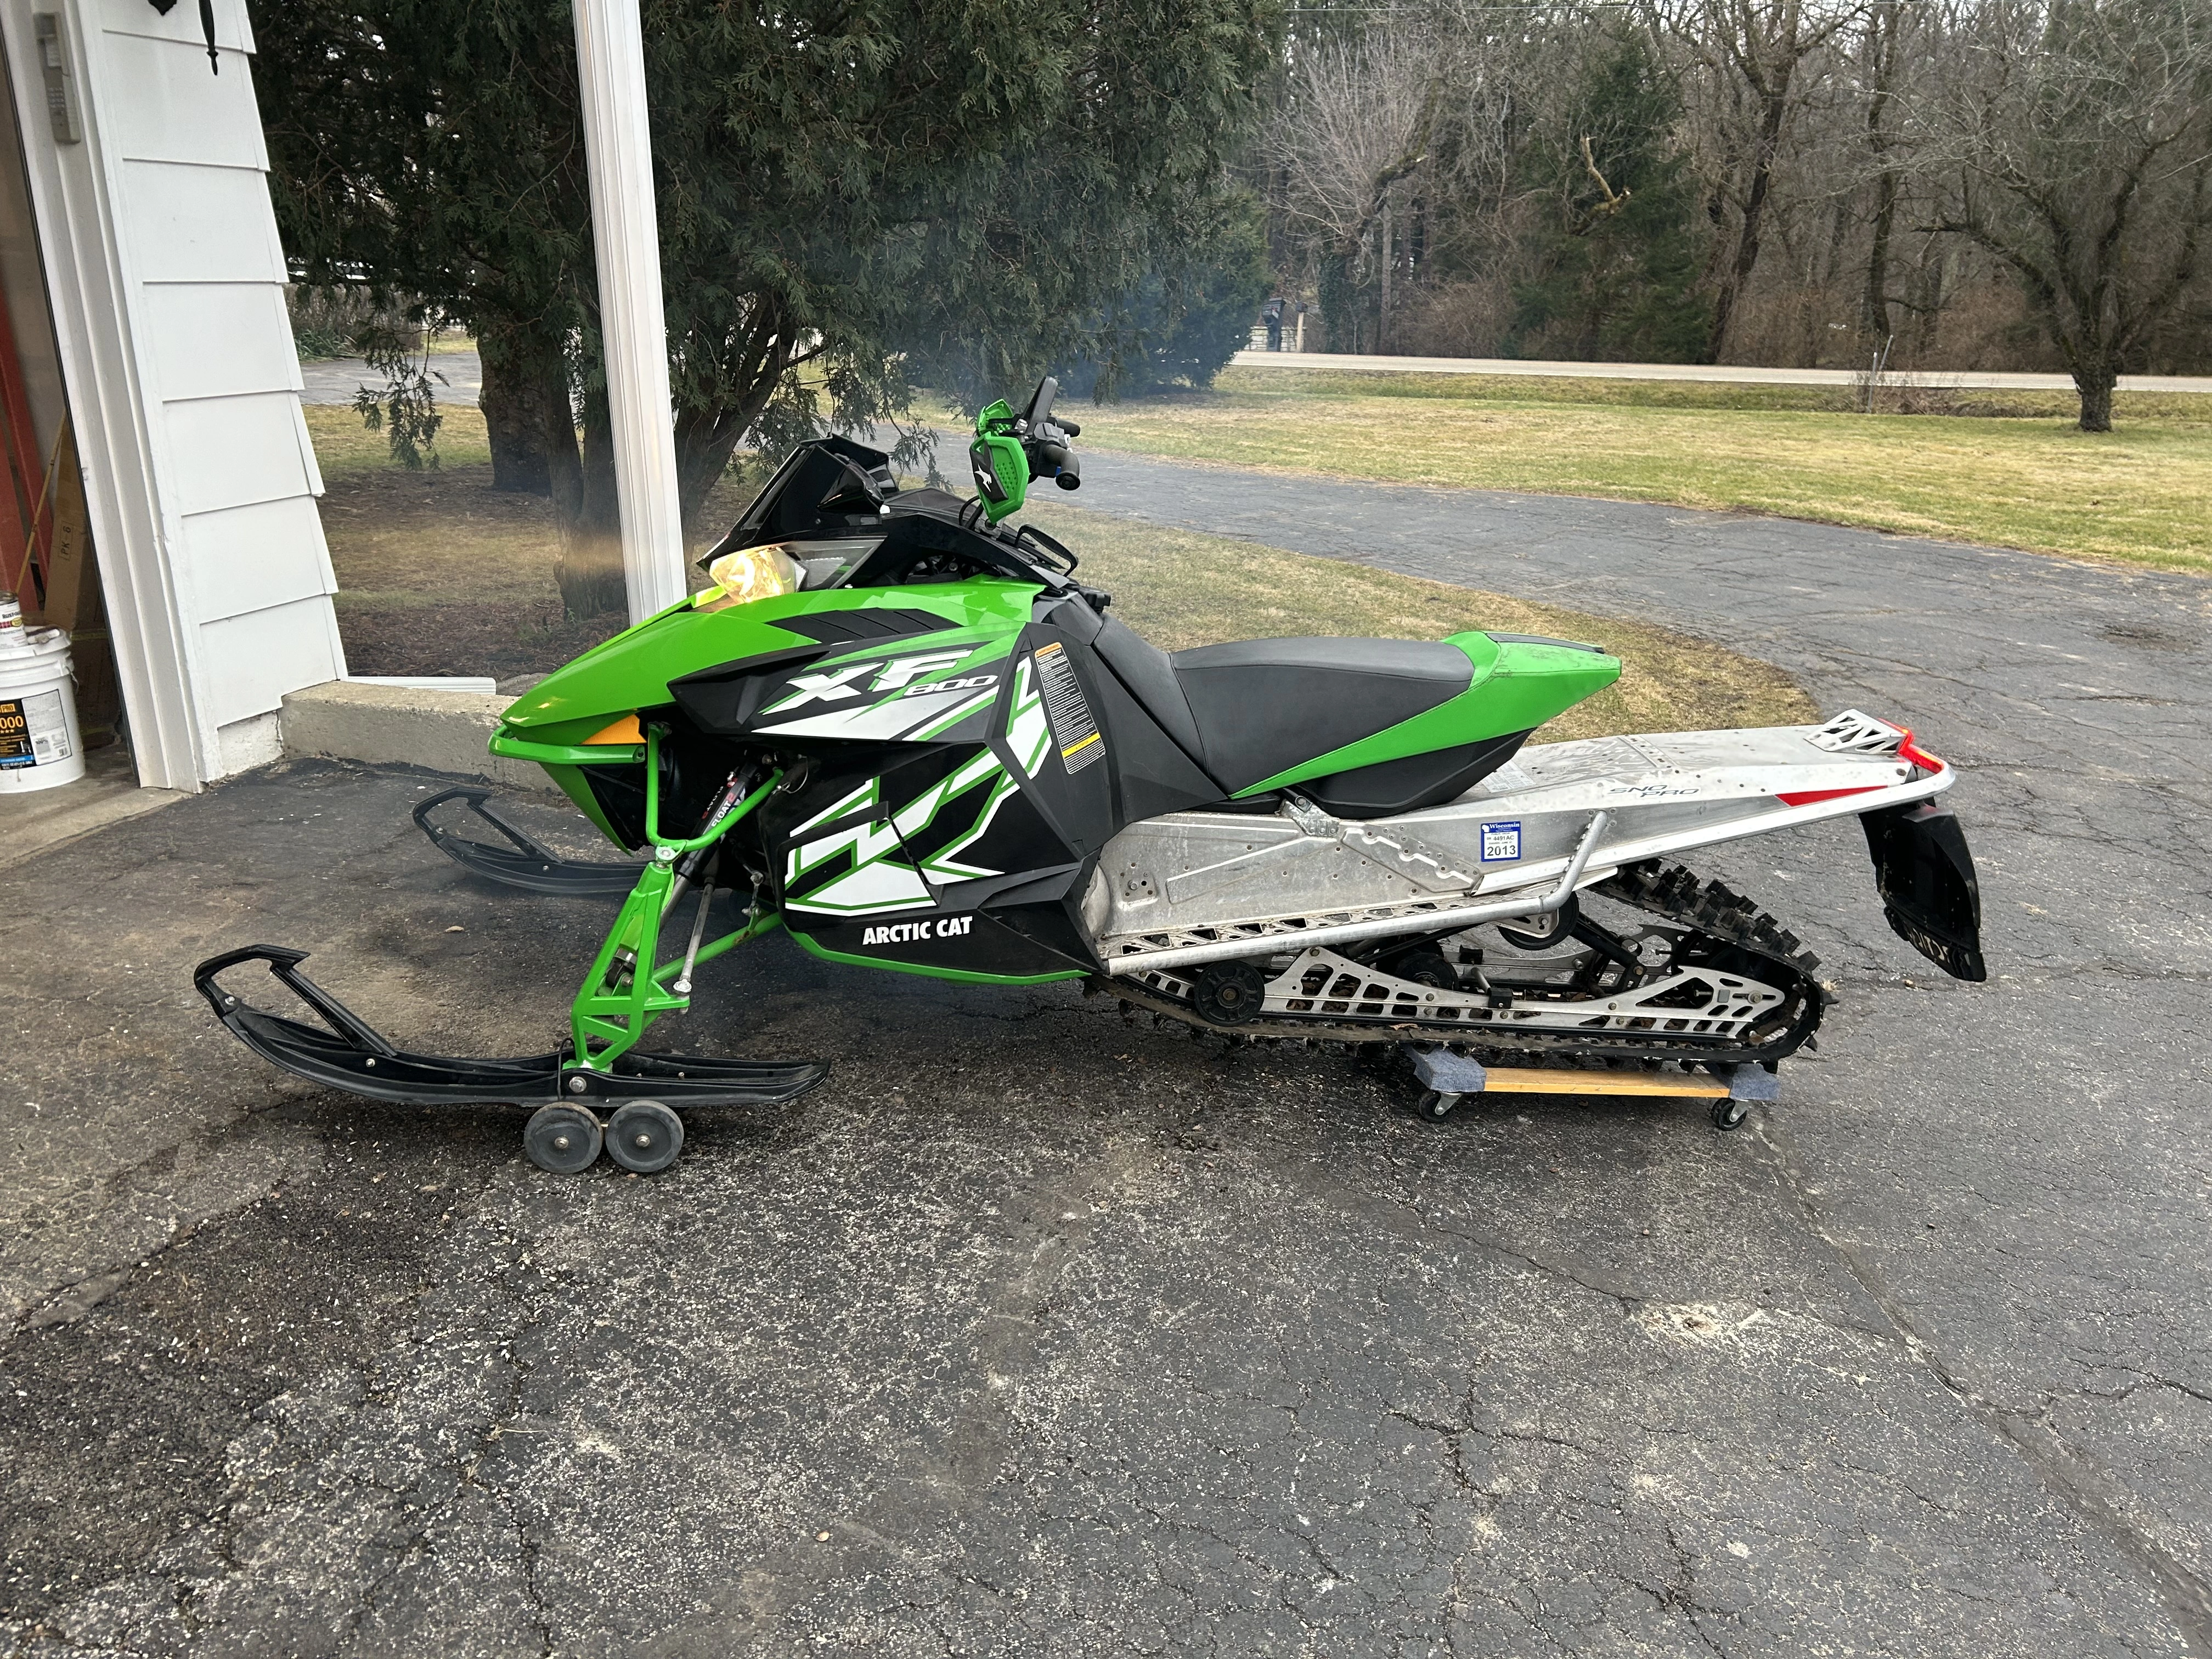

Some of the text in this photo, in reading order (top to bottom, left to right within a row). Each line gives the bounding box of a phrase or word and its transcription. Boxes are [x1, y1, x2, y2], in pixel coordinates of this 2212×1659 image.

[761, 650, 998, 715] XF 800
[1607, 785, 1668, 794] SNO
[1640, 788, 1700, 798] PRO
[1487, 845, 1516, 856] 2013
[862, 916, 973, 945] ARCTIC CAT
